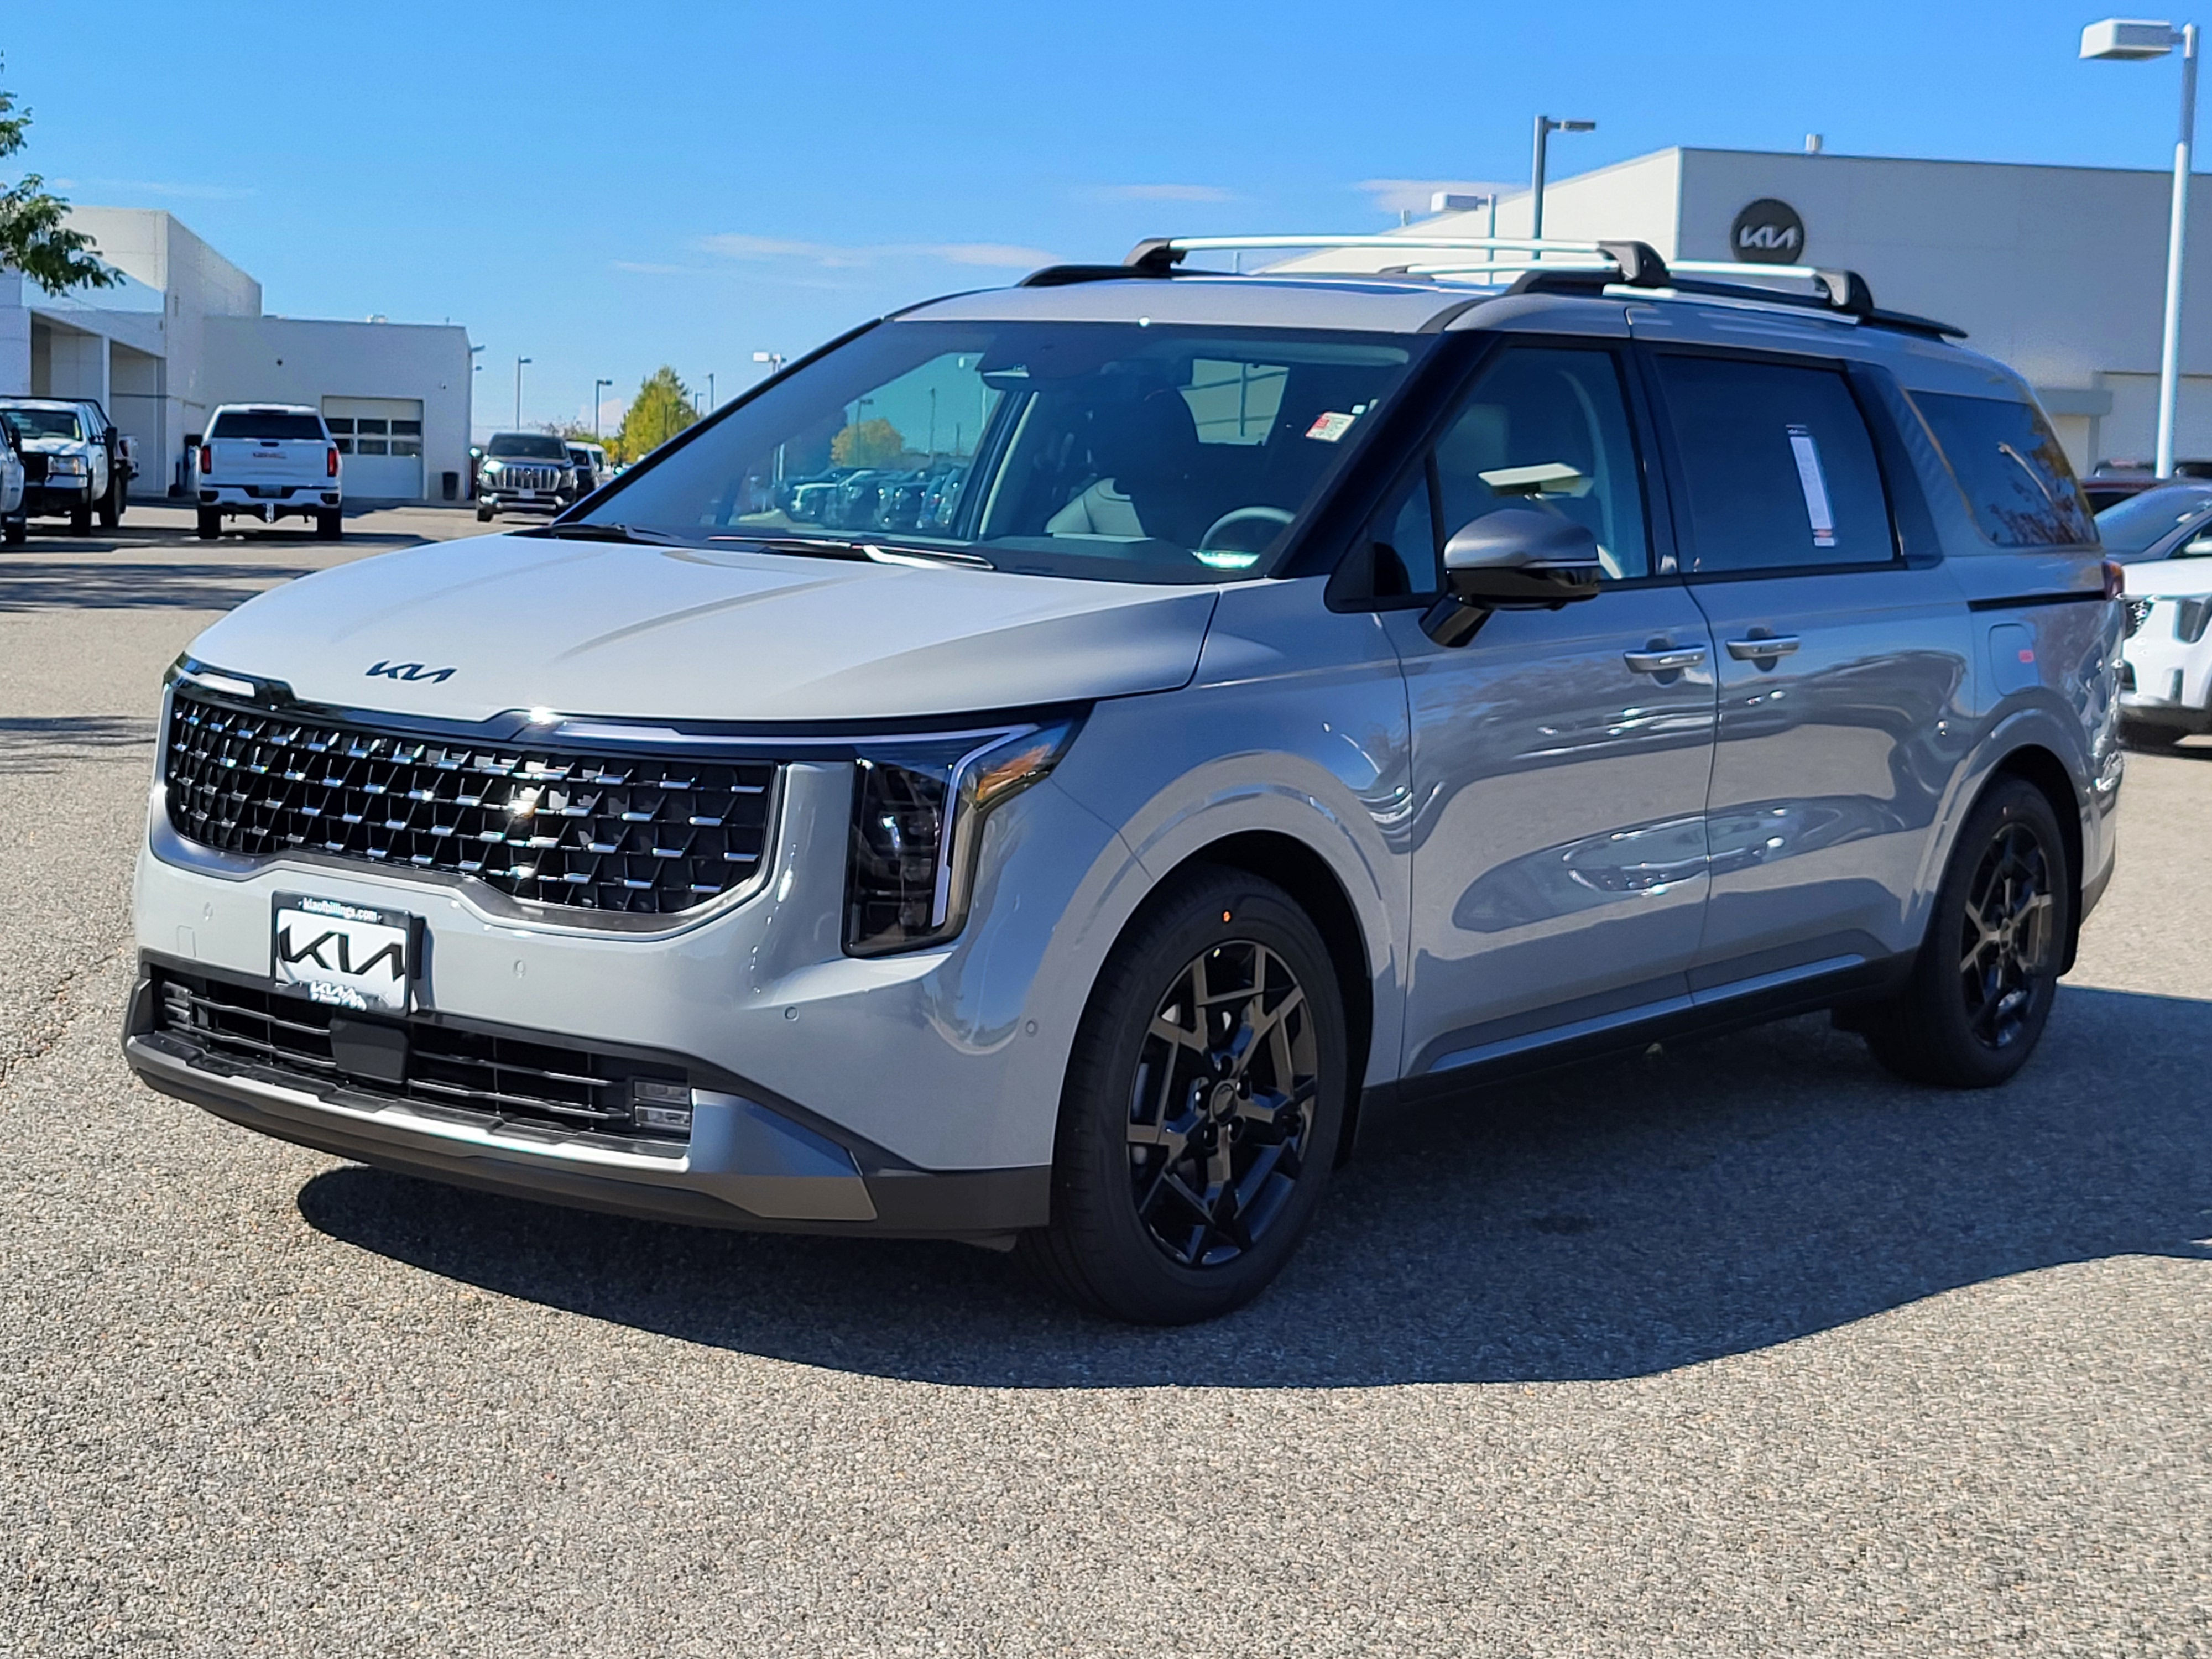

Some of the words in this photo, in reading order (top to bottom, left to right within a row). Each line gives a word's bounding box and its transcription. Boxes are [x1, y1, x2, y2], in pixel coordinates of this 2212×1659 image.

[1740, 226, 1796, 249] KIA
[365, 660, 457, 684] KIA
[279, 924, 405, 982] KIA
